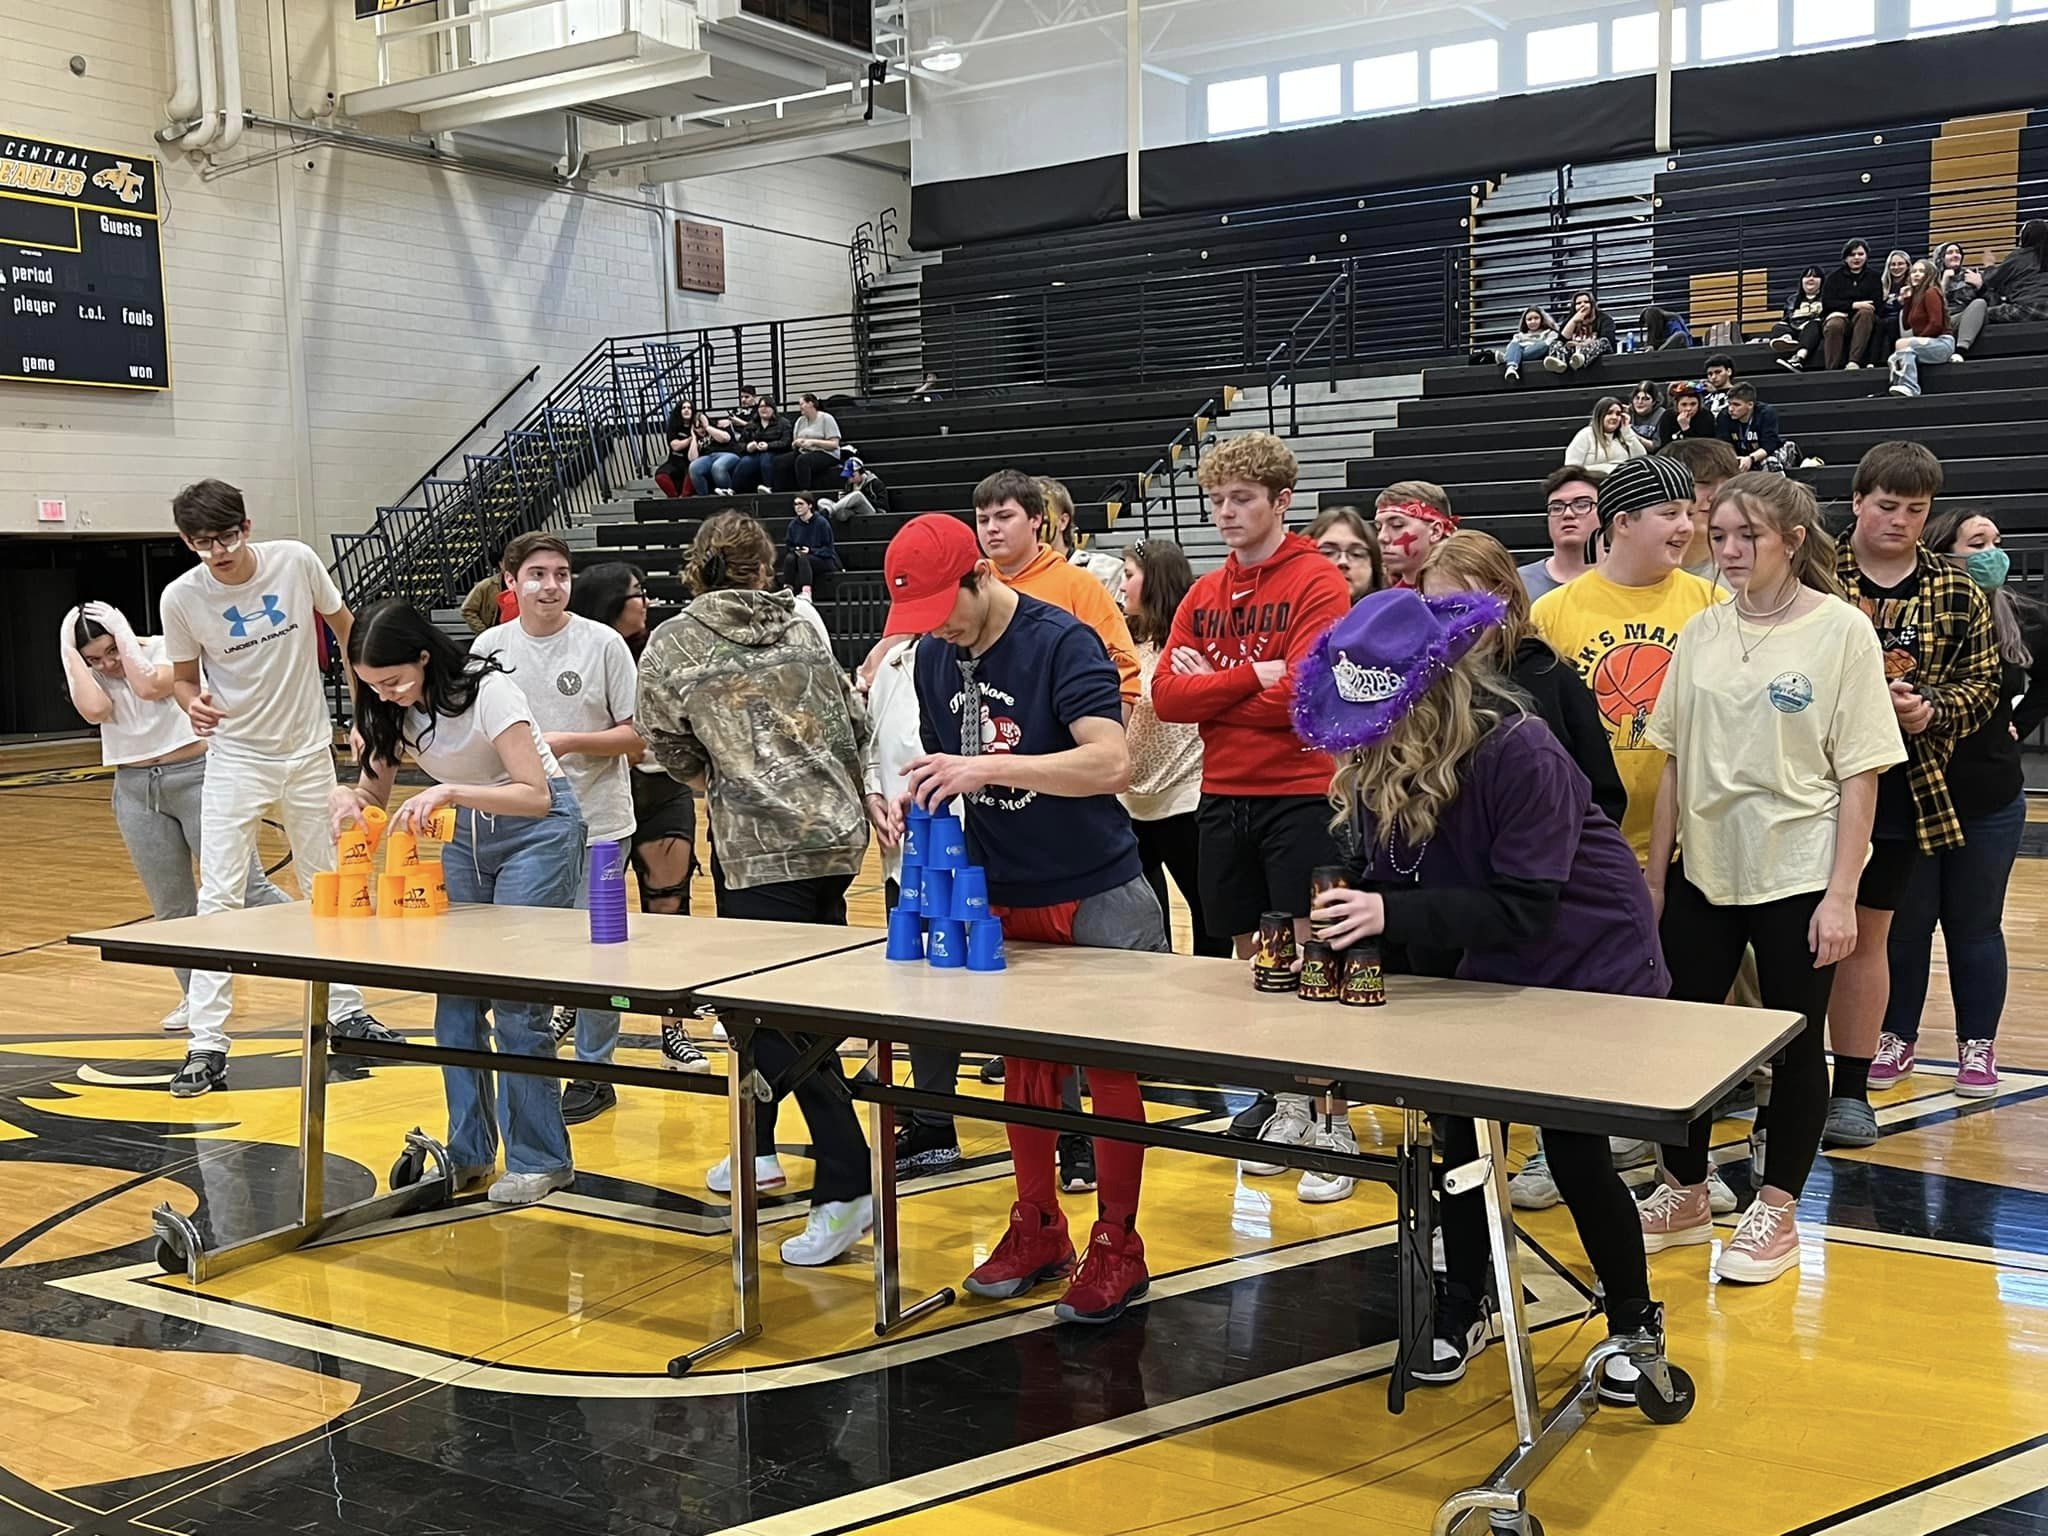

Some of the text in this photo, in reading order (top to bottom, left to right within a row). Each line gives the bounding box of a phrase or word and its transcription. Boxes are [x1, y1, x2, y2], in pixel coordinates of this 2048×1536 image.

[5, 142, 88, 169] CENTRAL
[0, 159, 87, 197] EAGLES
[100, 215, 142, 237] Guests
[12, 266, 53, 284] period
[13, 294, 56, 316] player
[122, 307, 153, 326] fouls
[22, 356, 55, 373] game
[129, 365, 153, 379] won
[1193, 602, 1290, 638] CHICAGO
[224, 623, 299, 654] UNDER ARMOUR
